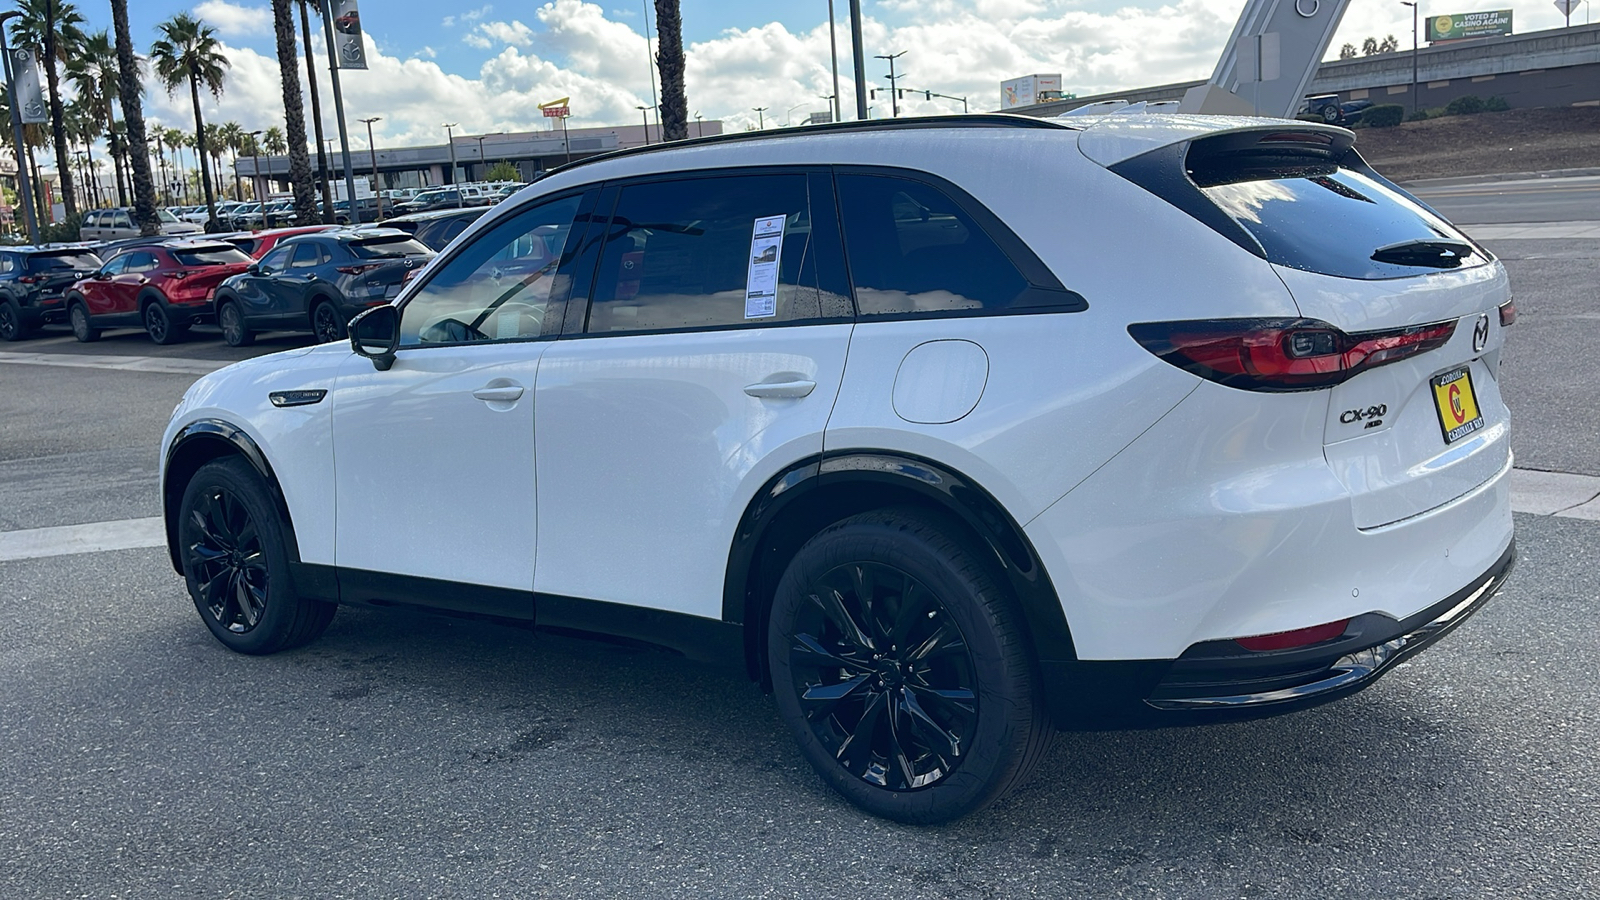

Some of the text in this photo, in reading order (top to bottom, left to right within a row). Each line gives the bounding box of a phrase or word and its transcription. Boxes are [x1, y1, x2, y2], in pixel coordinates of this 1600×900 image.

[1454, 19, 1482, 28] CASINO
[1483, 17, 1509, 26] AGAIN!
[1464, 13, 1489, 21] VOTED
[1441, 370, 1462, 385] CORONA
[1340, 403, 1388, 424] CX-90
